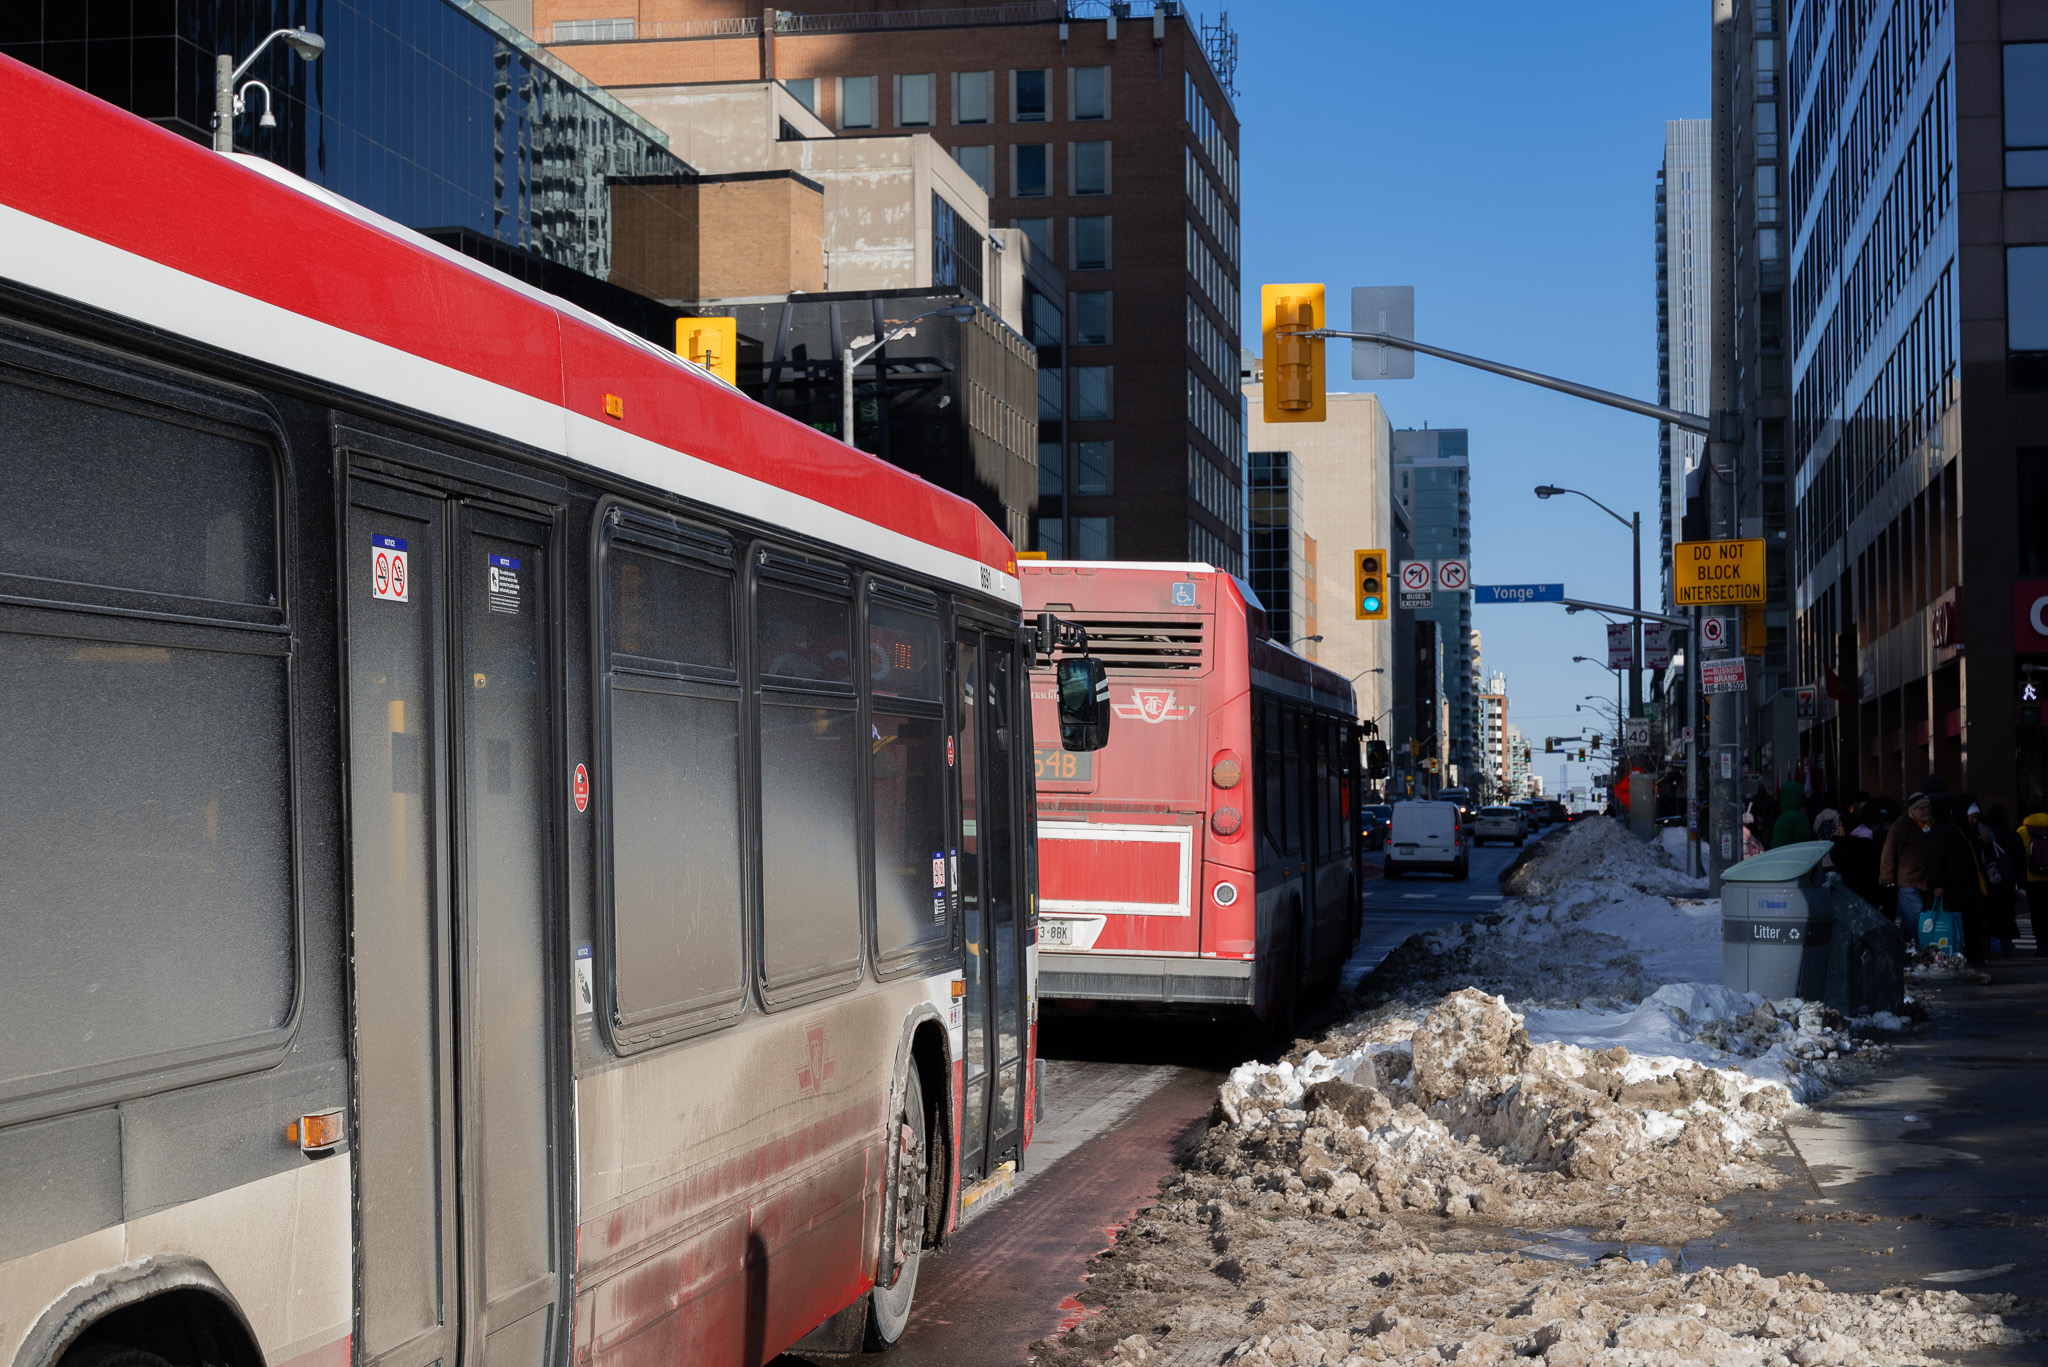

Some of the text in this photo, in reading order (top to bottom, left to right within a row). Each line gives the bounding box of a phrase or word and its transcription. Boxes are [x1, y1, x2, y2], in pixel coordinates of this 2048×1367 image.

[1694, 544, 1744, 560] DO NOT
[1698, 564, 1740, 580] BLOCK
[1493, 586, 1534, 601] Yonge
[1680, 584, 1760, 601] INTERSECTION
[1702, 660, 1744, 668] Canada-Brands.ca
[1713, 666, 1742, 675] BUSINESS
[1714, 674, 1738, 683] BRAND
[1704, 682, 1746, 693] 416-460-3523
[1031, 689, 1057, 700] nada
[1628, 730, 1648, 743] 40
[1754, 924, 1781, 939] Litter
[577, 947, 589, 957] NOTICE
